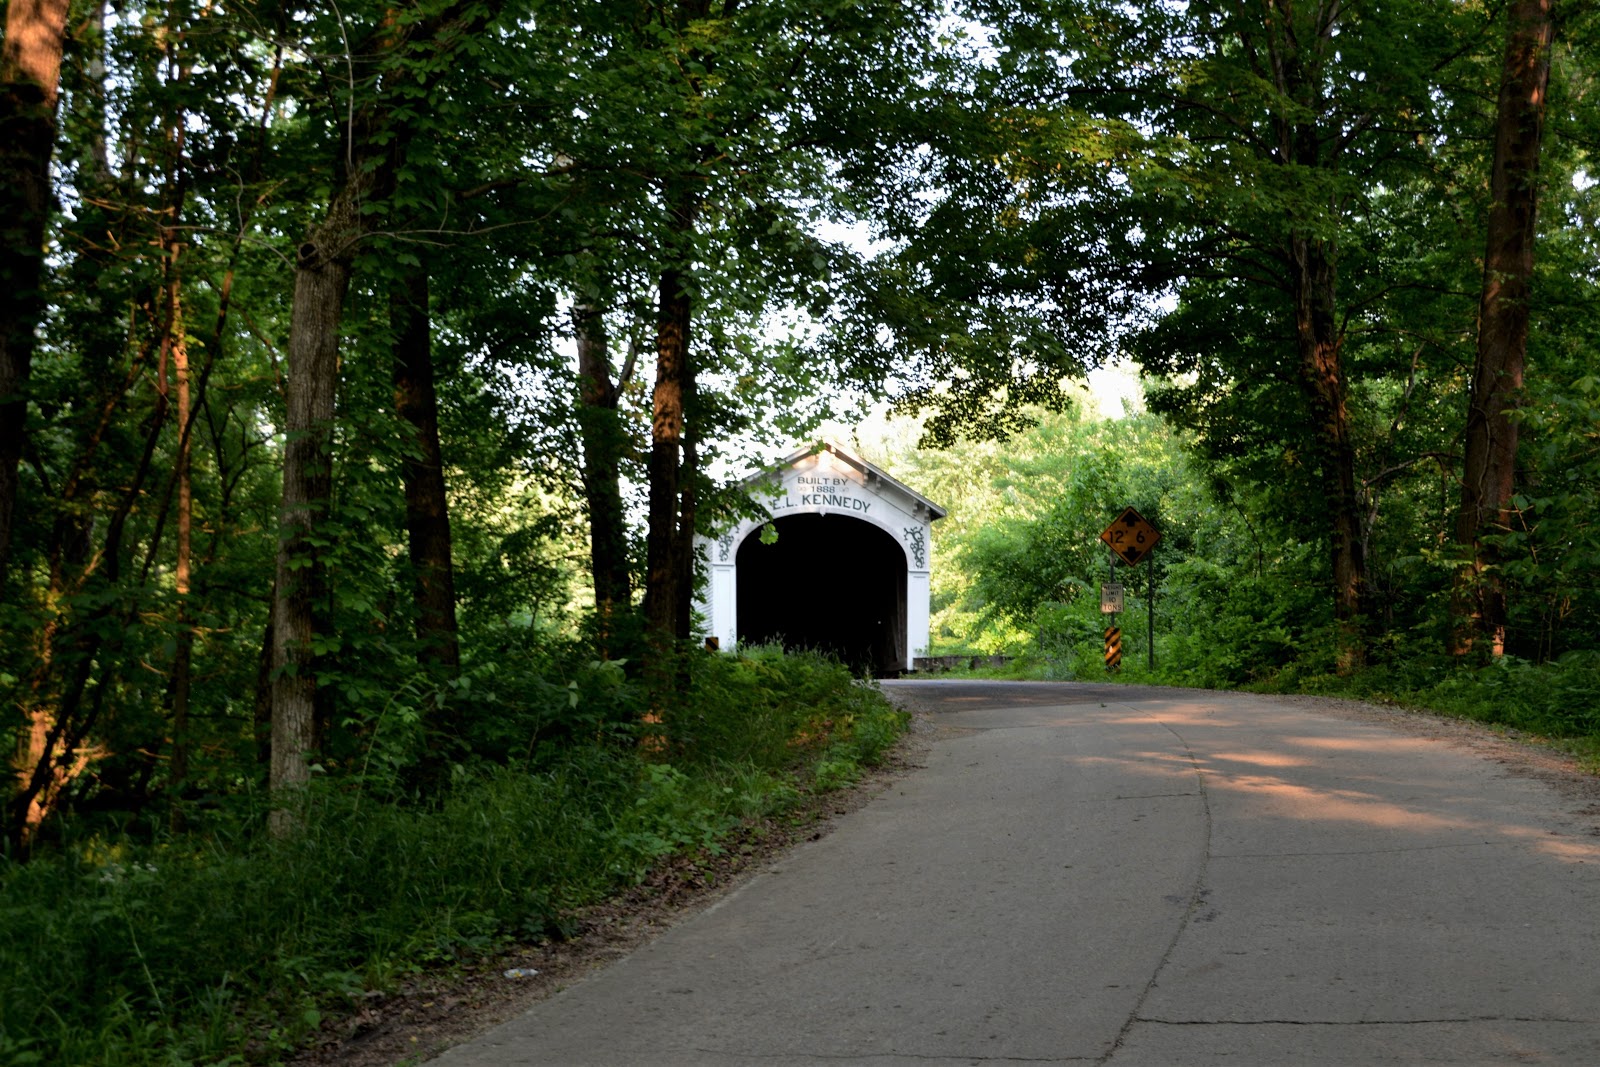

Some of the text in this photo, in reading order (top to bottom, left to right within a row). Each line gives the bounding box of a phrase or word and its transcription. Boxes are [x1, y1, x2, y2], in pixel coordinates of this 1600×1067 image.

[797, 476, 849, 486] BUILT BY
[811, 486, 836, 494] 1888
[772, 494, 871, 513] E.L. KENNEDY
[1103, 603, 1122, 611] TONS
